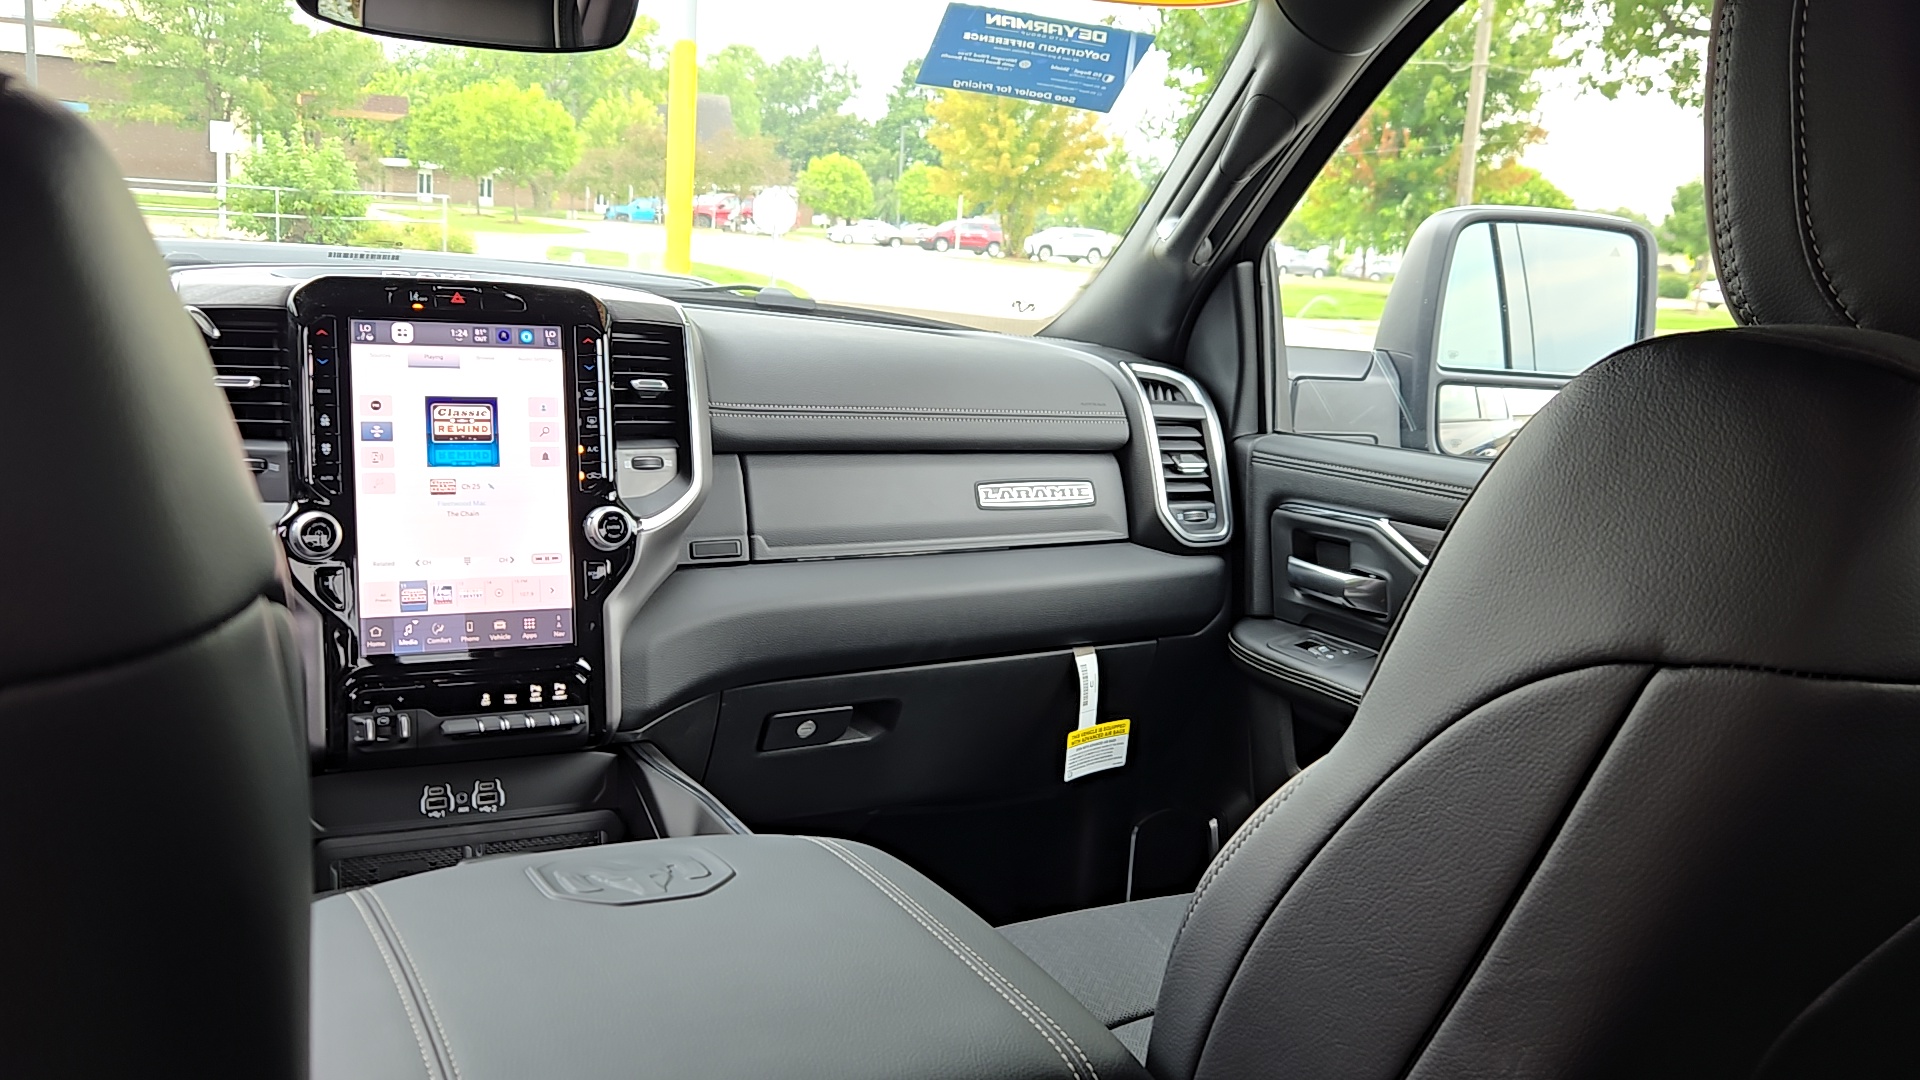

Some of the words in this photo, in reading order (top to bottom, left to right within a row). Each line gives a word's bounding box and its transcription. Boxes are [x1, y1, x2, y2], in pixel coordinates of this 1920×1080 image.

[358, 323, 372, 332] LO
[450, 328, 469, 338] 1:24
[544, 329, 557, 338] LO
[437, 408, 488, 417] Classic
[438, 425, 489, 433] REWIND
[981, 485, 1091, 500] LARAMIE
[366, 640, 387, 648] Home
[398, 638, 419, 646] Media
[426, 637, 452, 645] Comfort
[460, 635, 480, 643] Phone
[489, 633, 512, 641] Vehicle
[521, 632, 538, 640] Apps
